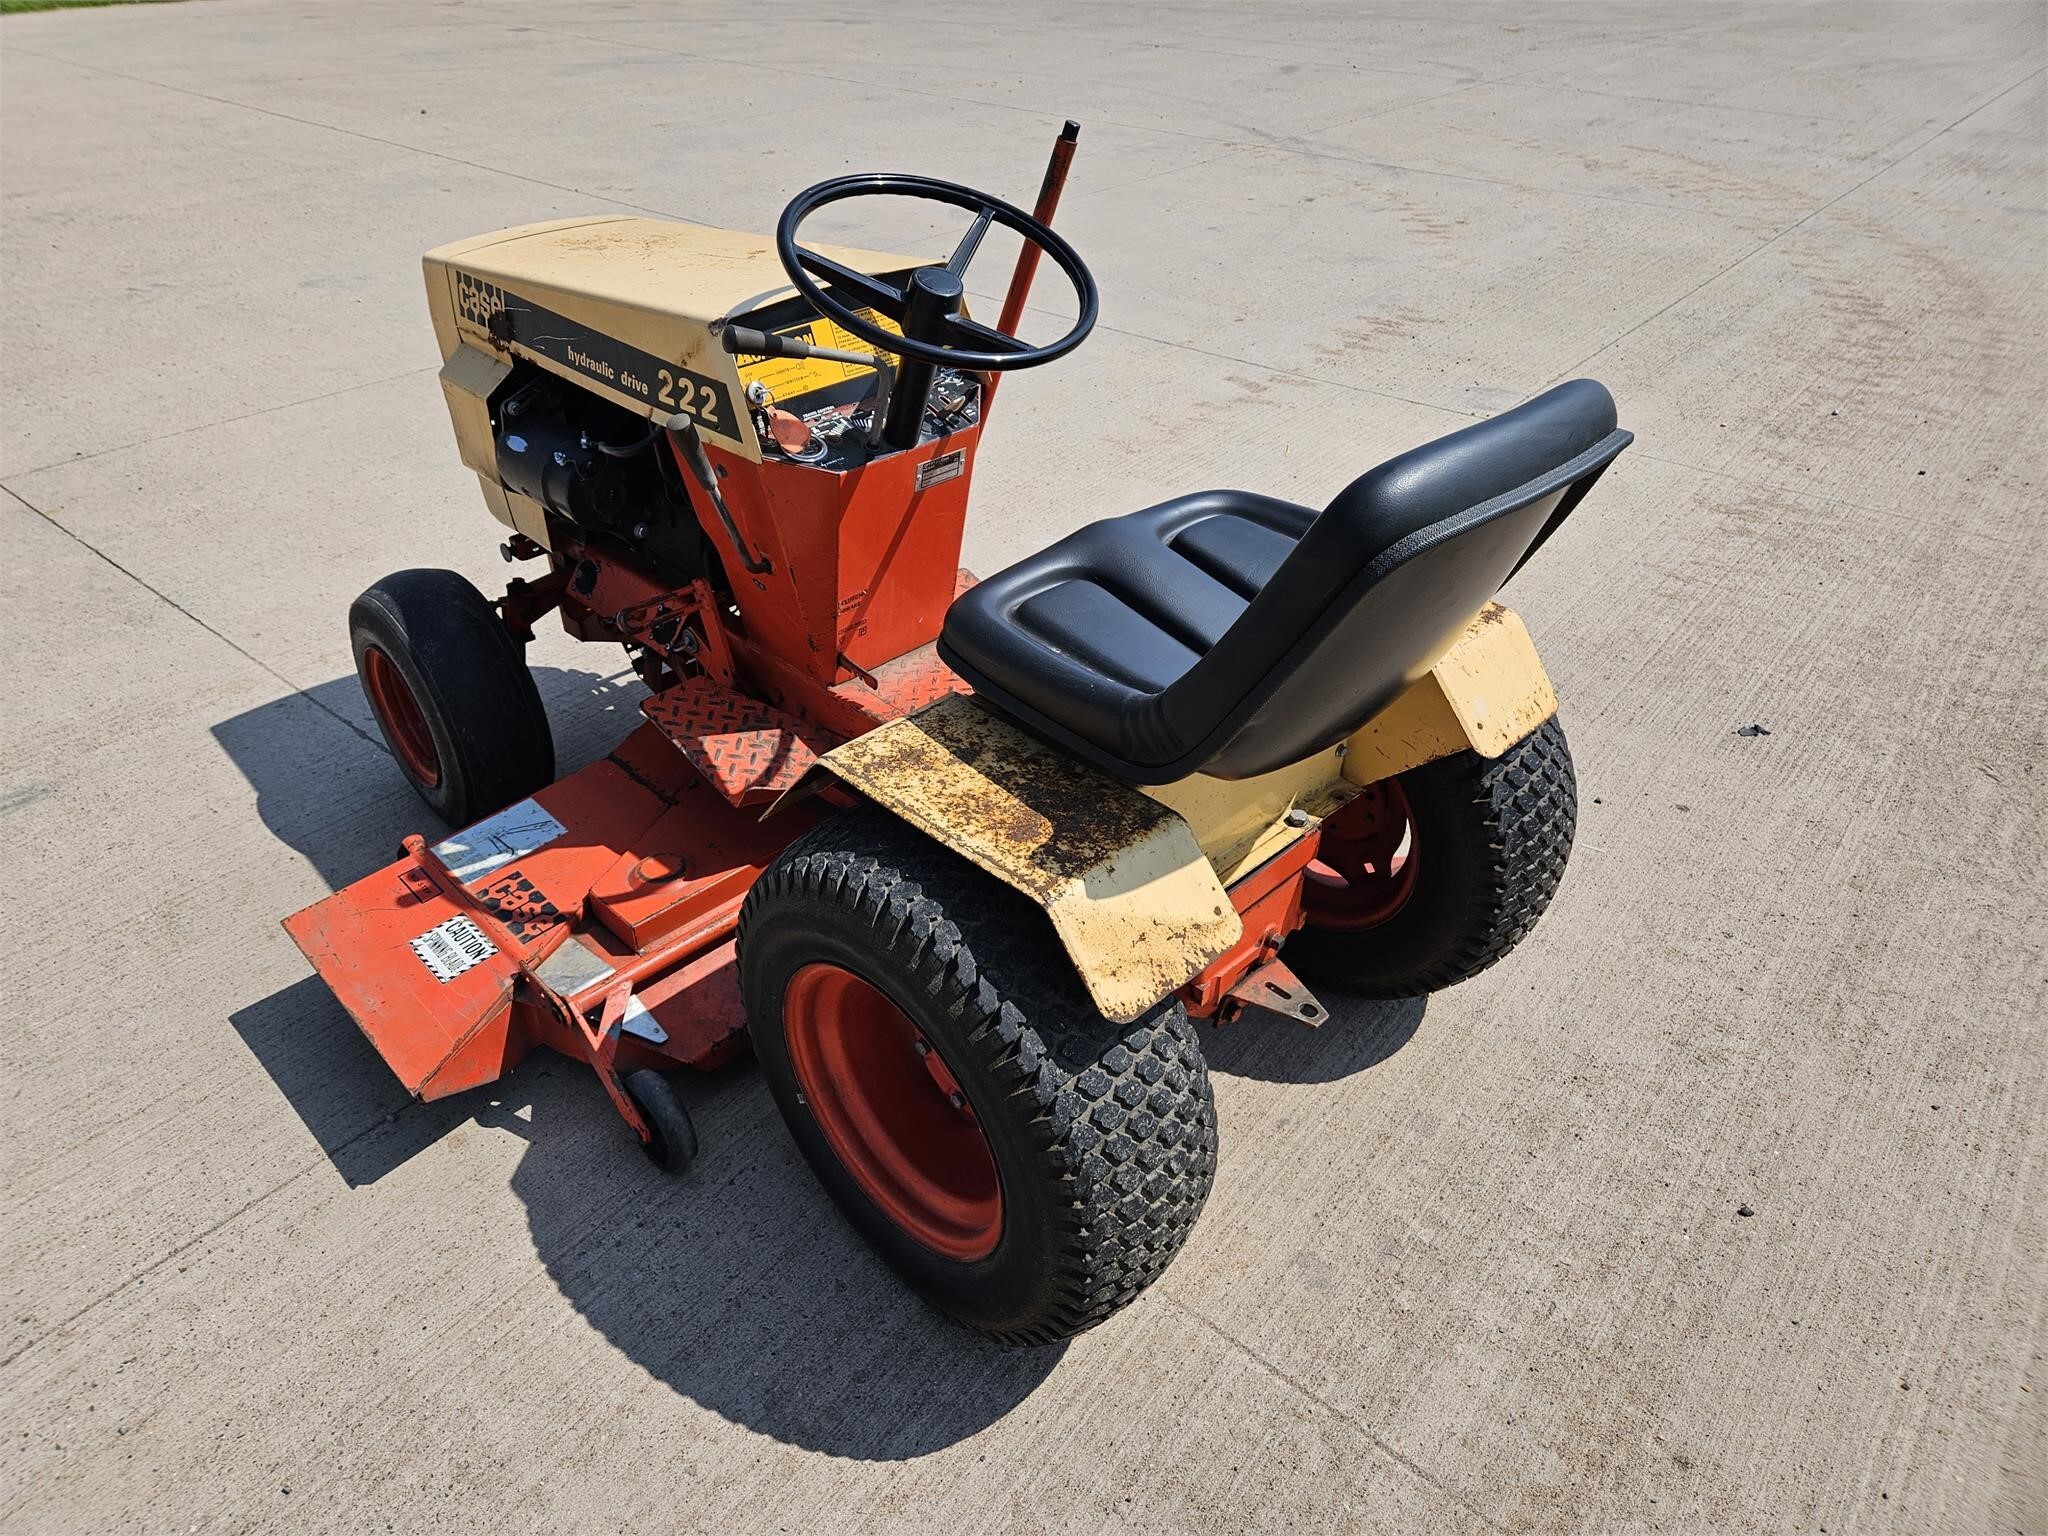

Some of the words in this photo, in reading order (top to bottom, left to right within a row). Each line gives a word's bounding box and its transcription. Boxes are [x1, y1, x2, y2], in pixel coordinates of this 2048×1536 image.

[567, 346, 615, 380] hydraulic
[620, 371, 649, 396] drive
[657, 369, 718, 423] 222
[445, 920, 489, 960] CAUTION
